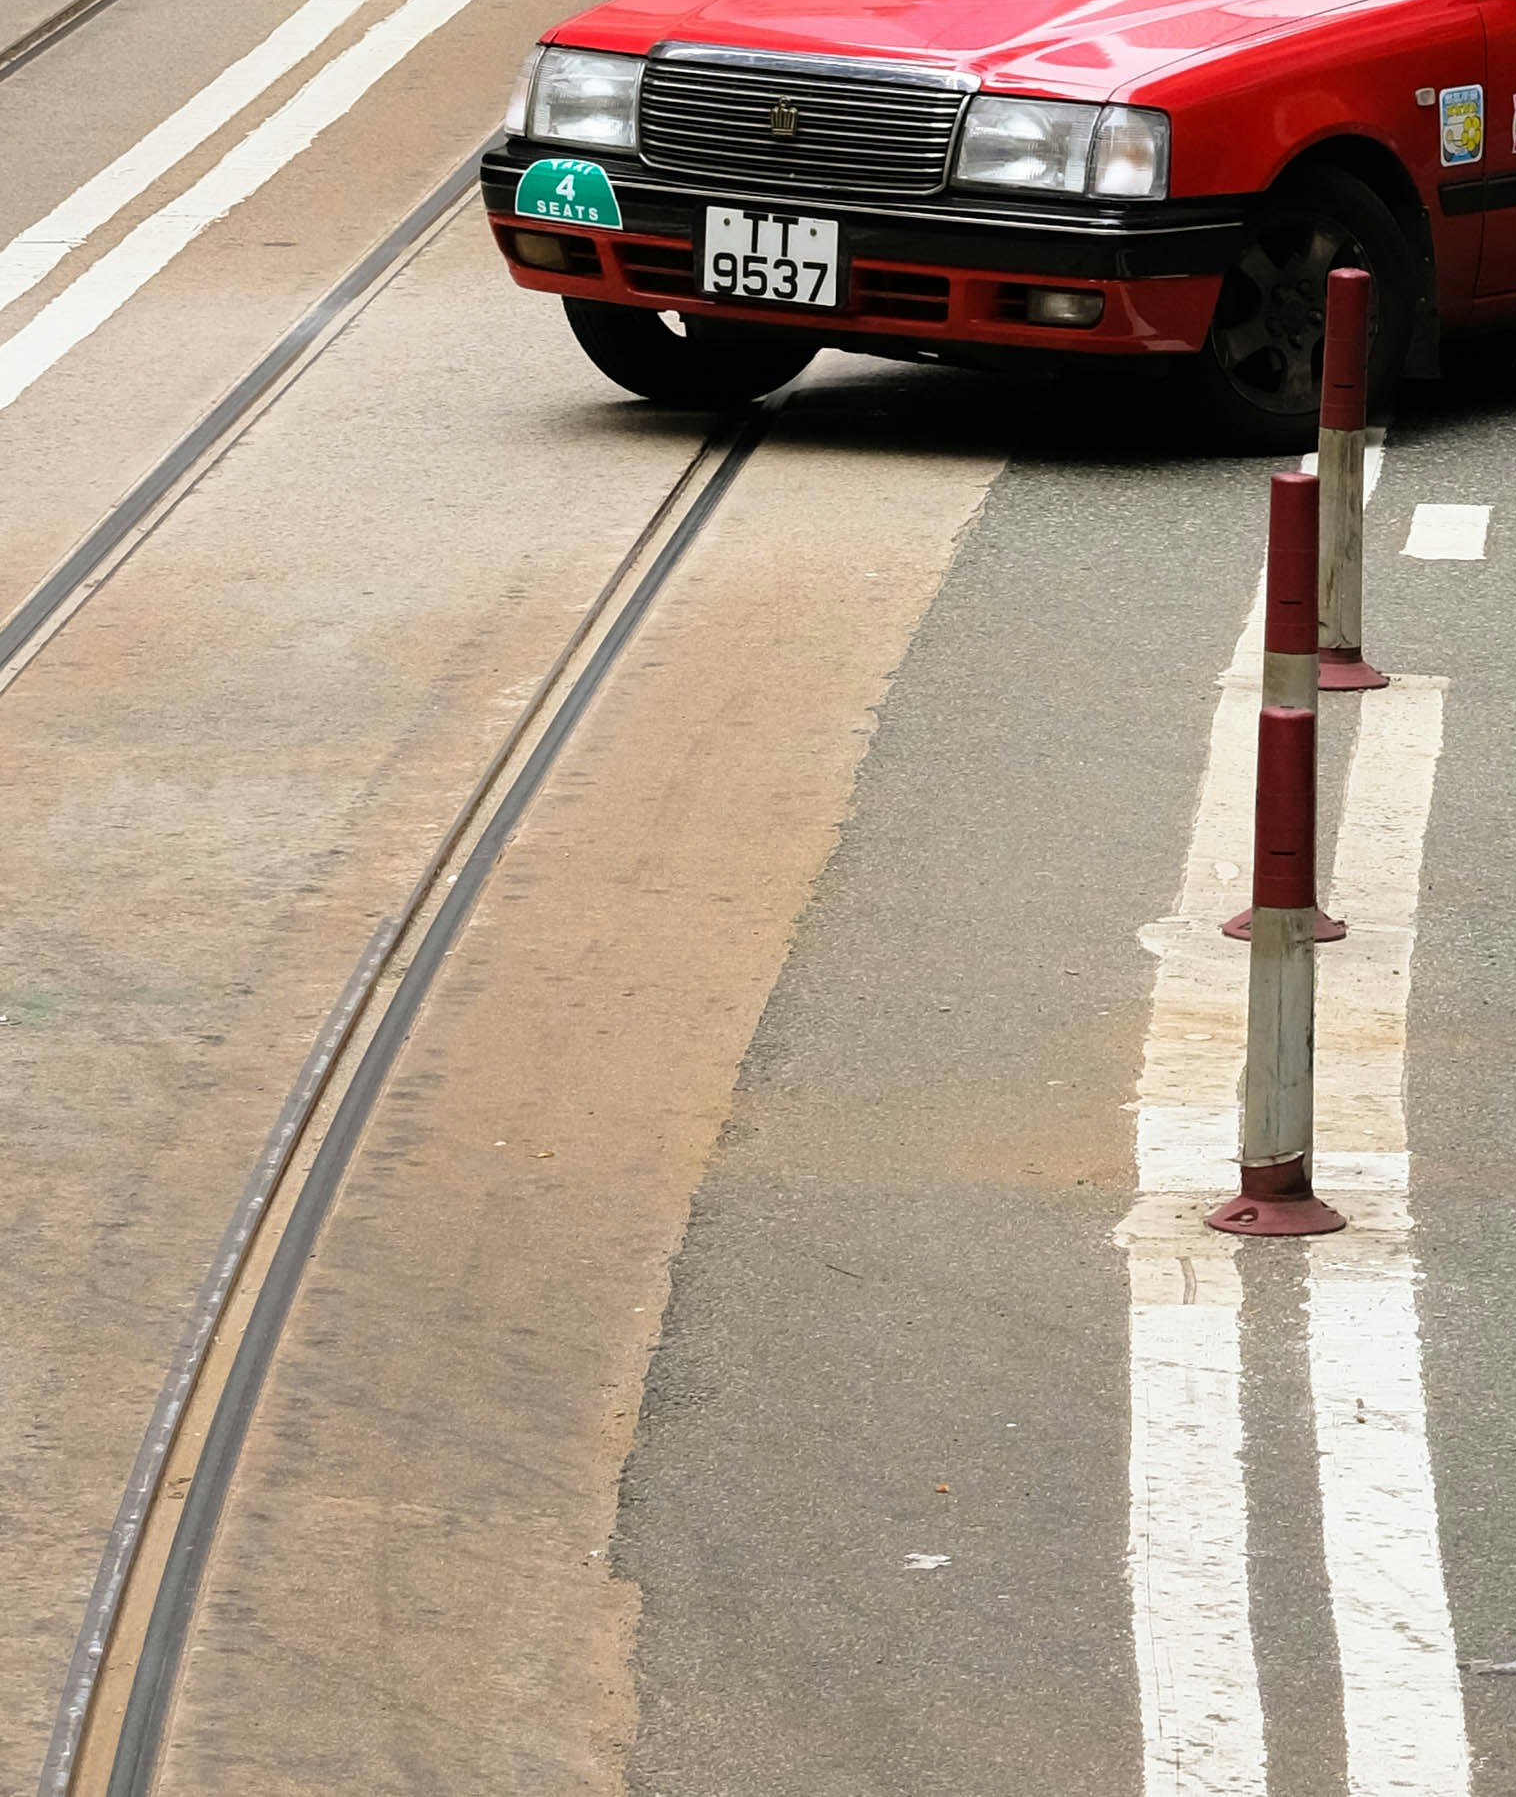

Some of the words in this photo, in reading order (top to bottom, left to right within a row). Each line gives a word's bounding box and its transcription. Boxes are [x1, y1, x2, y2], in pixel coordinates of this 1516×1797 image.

[555, 174, 576, 201] 4
[536, 200, 599, 222] SEATS
[743, 210, 799, 257] TT
[712, 252, 829, 302] 9537
